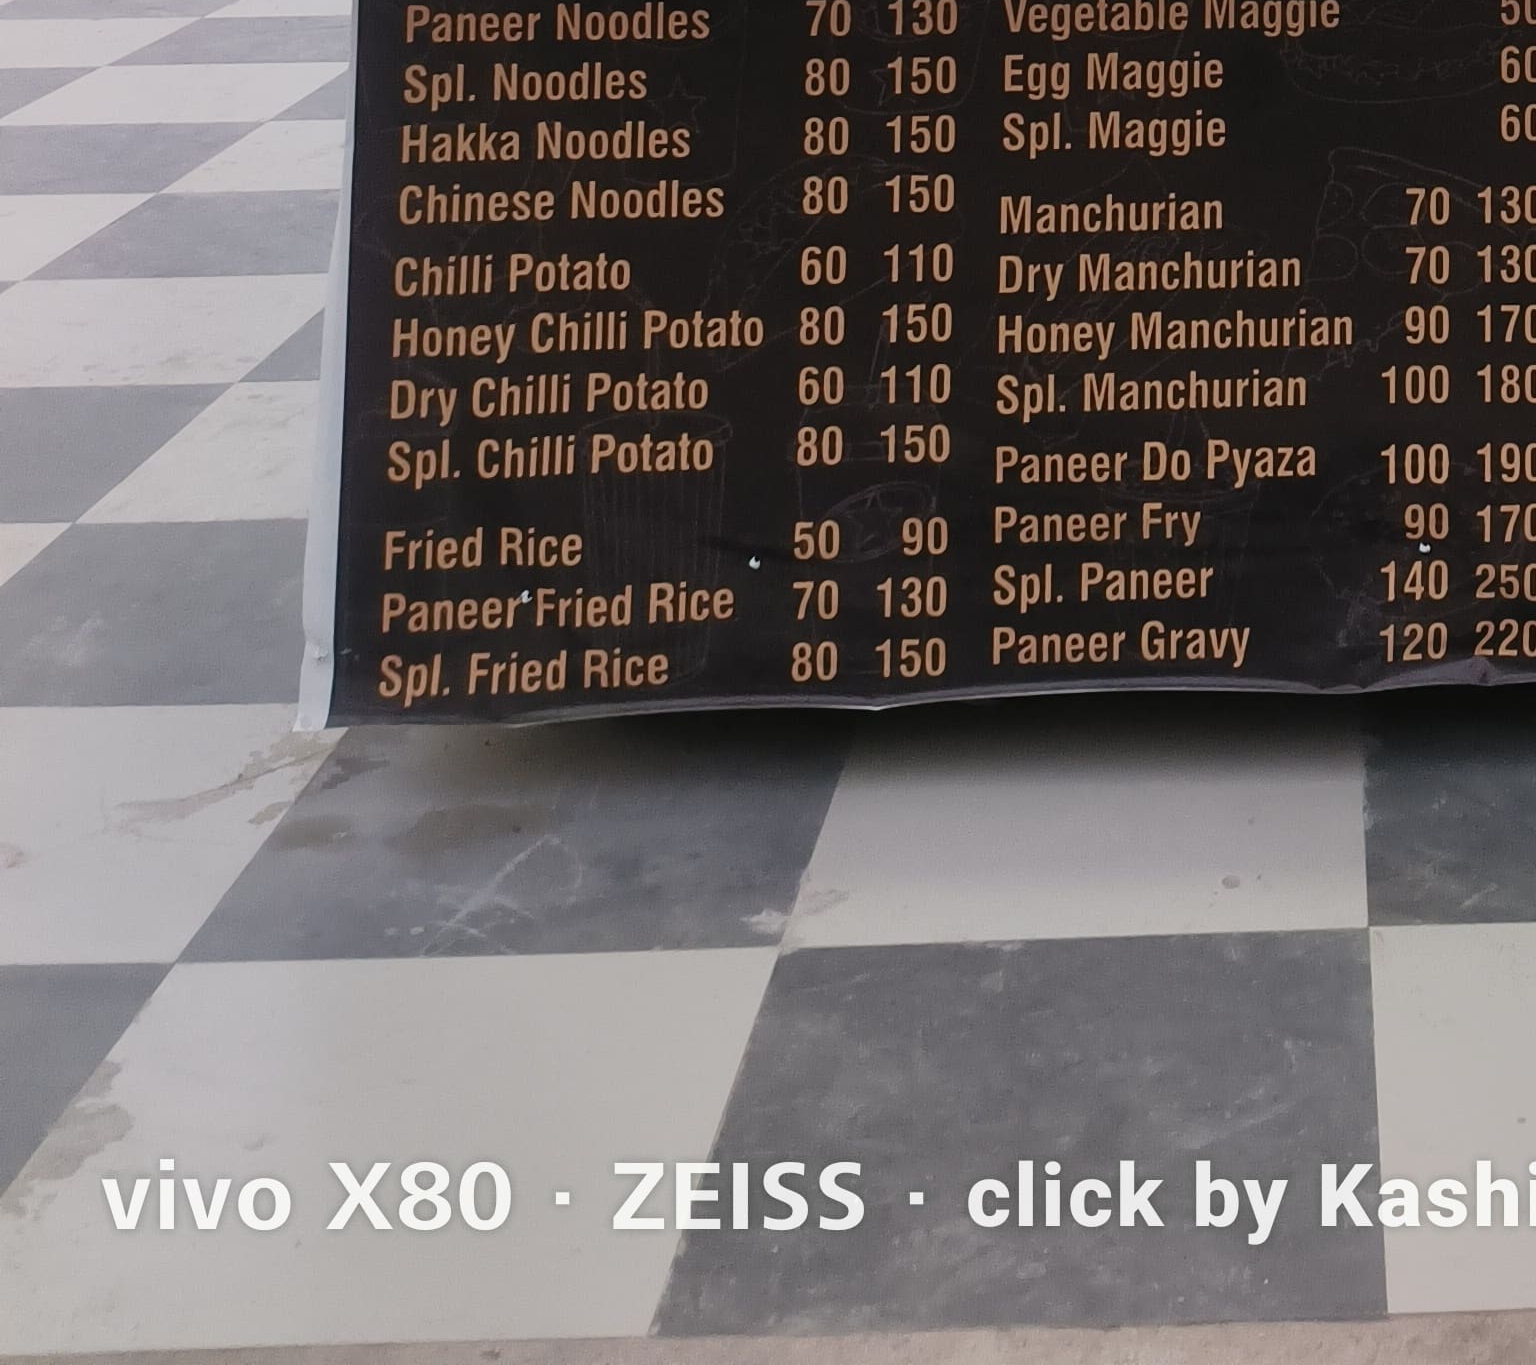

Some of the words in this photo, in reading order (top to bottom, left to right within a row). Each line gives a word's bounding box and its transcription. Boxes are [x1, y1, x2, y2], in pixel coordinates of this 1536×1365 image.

[407, 5, 540, 42] Paneer
[557, 2, 709, 40] Noodles
[806, 0, 851, 36] 70
[404, 64, 475, 111] Spl.
[494, 62, 646, 101] Noodles
[805, 58, 849, 95] 80
[888, 56, 956, 94] 150
[1003, 112, 1071, 159] Spl.
[1089, 111, 1225, 156] Maggie
[1001, 193, 1222, 234] Manchurian
[1406, 187, 1449, 225] 70
[395, 255, 492, 296] Chilli
[510, 253, 630, 292] Potato
[801, 246, 846, 285] 60
[884, 243, 953, 282] 110
[390, 380, 457, 427] Dry
[473, 374, 570, 418] Chilli
[587, 373, 708, 412] Potato
[799, 366, 844, 405] 60
[881, 364, 950, 403] 110
[997, 374, 1065, 423] Spl.
[1084, 369, 1306, 412] Manchurian
[1382, 365, 1449, 404] 100
[388, 439, 460, 489] Spl.
[478, 436, 575, 478] Chilli
[591, 433, 713, 473] Potato
[797, 426, 842, 466] 80
[881, 424, 950, 463] 150
[996, 446, 1127, 483] Paneer
[1143, 442, 1190, 480] Do
[1208, 439, 1315, 488] Pyaza
[1381, 444, 1449, 484] 100
[382, 593, 522, 633] Paneer
[536, 585, 632, 627] Fried
[649, 582, 733, 624] Rice
[793, 580, 838, 620] 70
[877, 576, 946, 617] 130
[994, 564, 1063, 613] Spl.
[1081, 562, 1213, 601] Paneer
[1381, 560, 1448, 601] 140
[993, 627, 1125, 665] Paneer
[1141, 621, 1249, 668] Gravy
[1380, 623, 1447, 662] 120
[379, 654, 449, 708] Spl.
[468, 650, 567, 694] Fried
[584, 648, 668, 688] Rice
[792, 641, 837, 681] 80
[876, 638, 945, 677] 150
